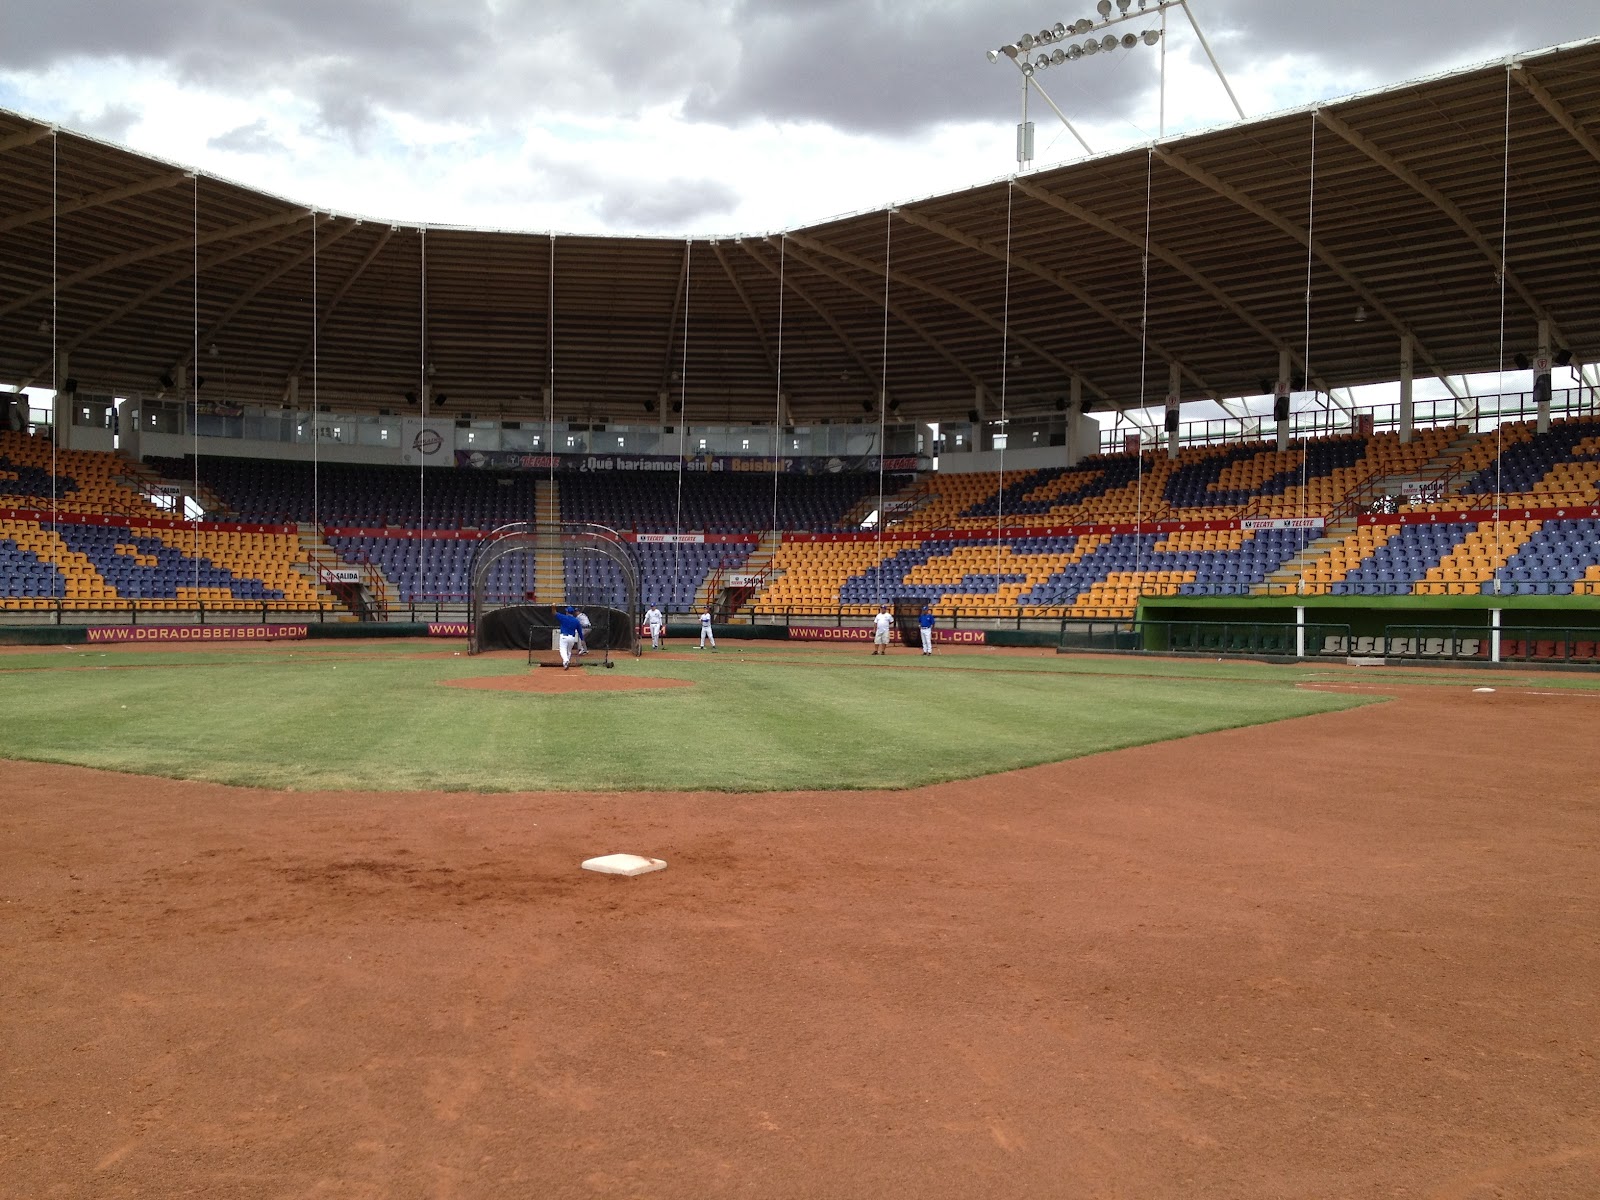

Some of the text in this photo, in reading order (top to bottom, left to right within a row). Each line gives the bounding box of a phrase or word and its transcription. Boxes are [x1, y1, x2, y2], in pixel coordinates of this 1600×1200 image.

[579, 456, 614, 473] ¿Qué
[160, 486, 180, 494] SALIDA
[1419, 482, 1443, 491] SALIDA
[1252, 519, 1315, 529] TECATE TECATE
[335, 572, 359, 581] SALIDA
[743, 577, 764, 585] SALIDA
[88, 626, 308, 640] WWW.DORADOSBEISBOL.COM
